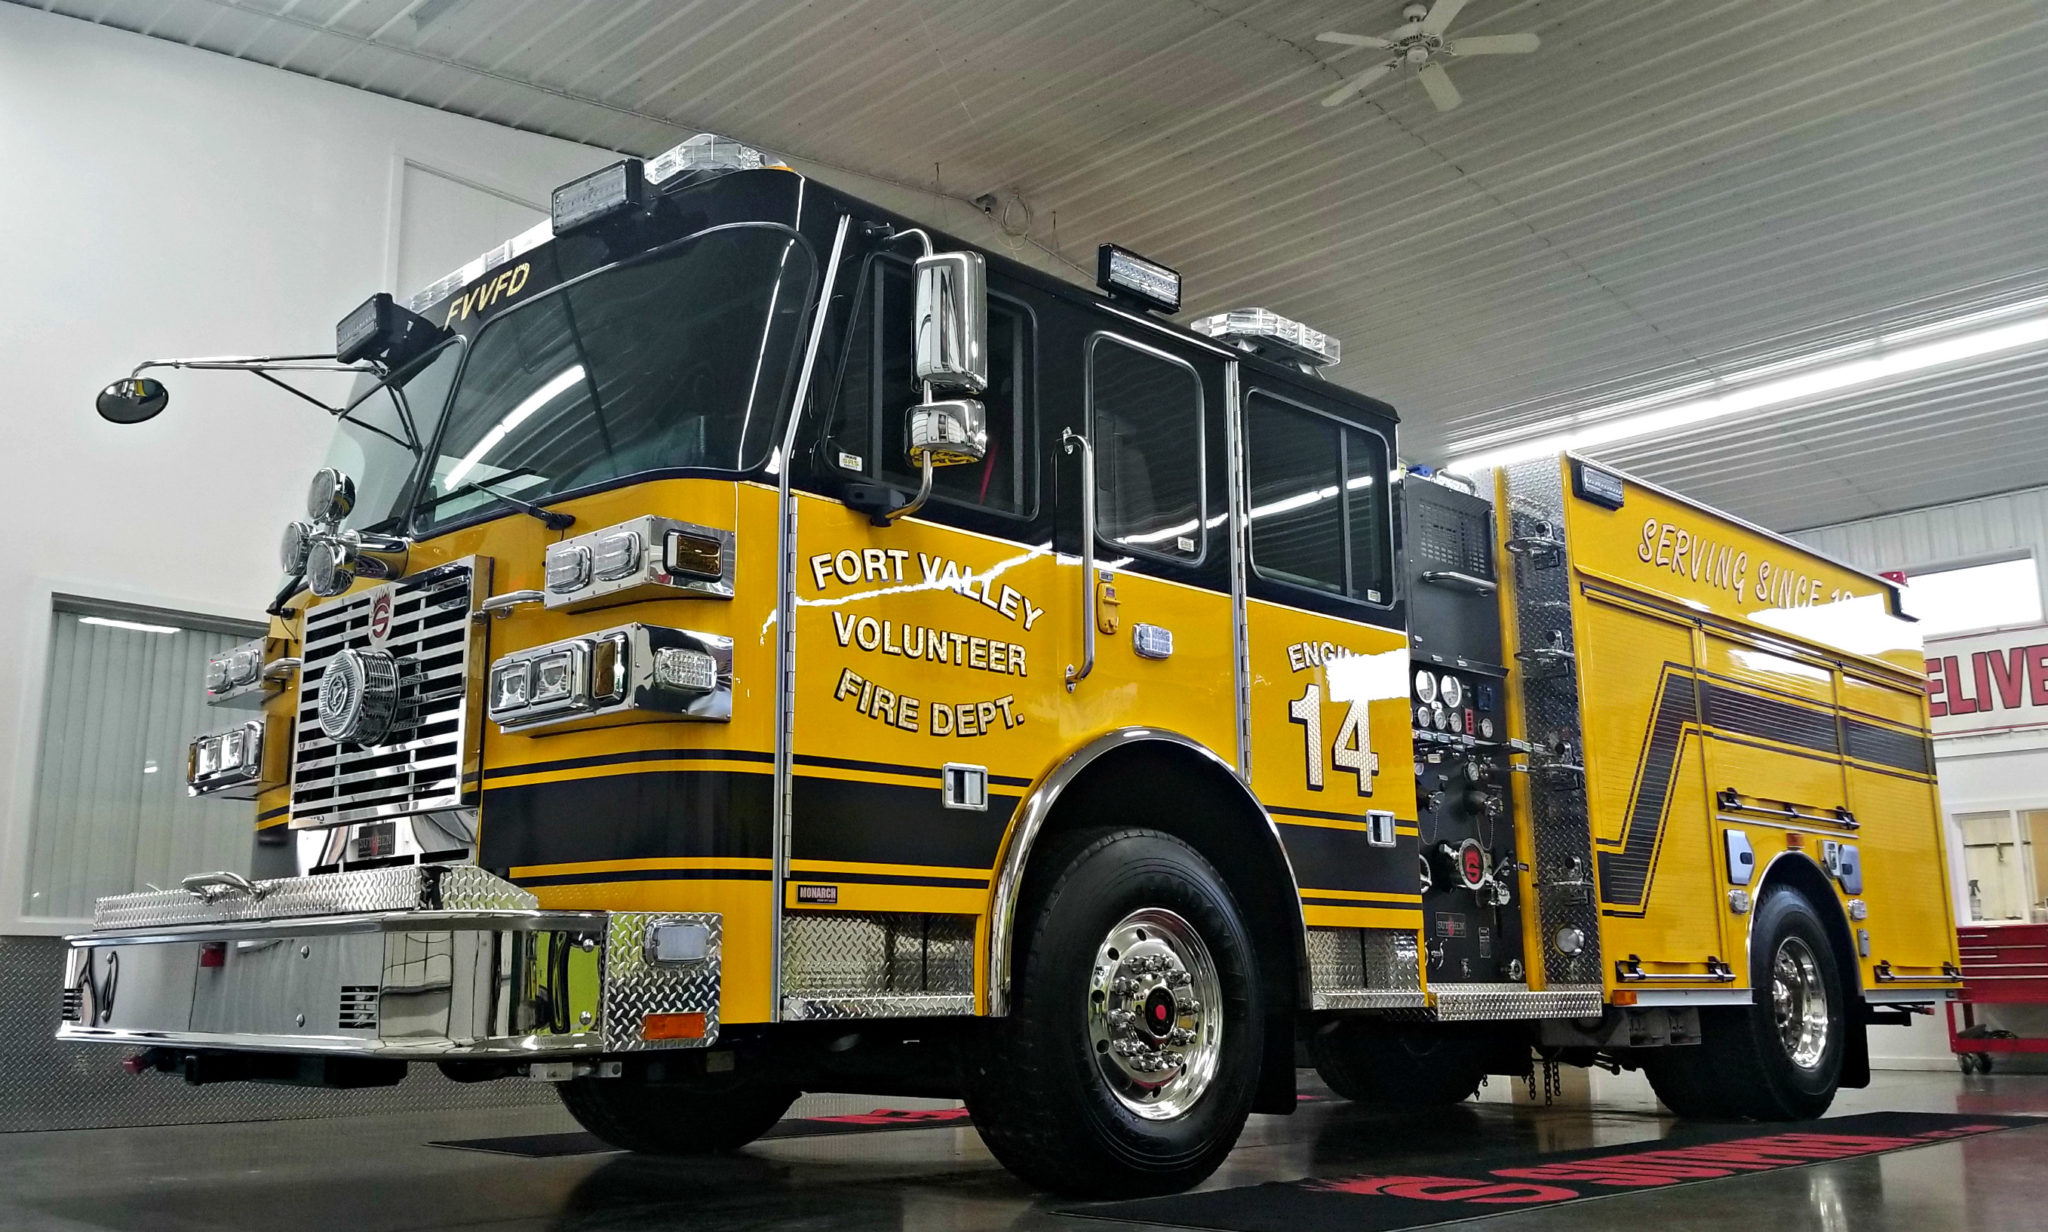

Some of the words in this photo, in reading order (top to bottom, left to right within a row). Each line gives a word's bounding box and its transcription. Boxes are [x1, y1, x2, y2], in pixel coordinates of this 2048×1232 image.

[442, 262, 531, 333] FVVFD
[810, 548, 910, 591] FORT
[917, 551, 1045, 632] VALLEY
[1638, 518, 1749, 604] SERVING
[1755, 559, 1824, 609] SINCE
[832, 610, 1028, 677] VOLUNTEER
[833, 667, 921, 733] FIRE
[929, 694, 1025, 738] DEPT.
[1289, 683, 1379, 798] 14
[799, 886, 837, 899] MONARCH
